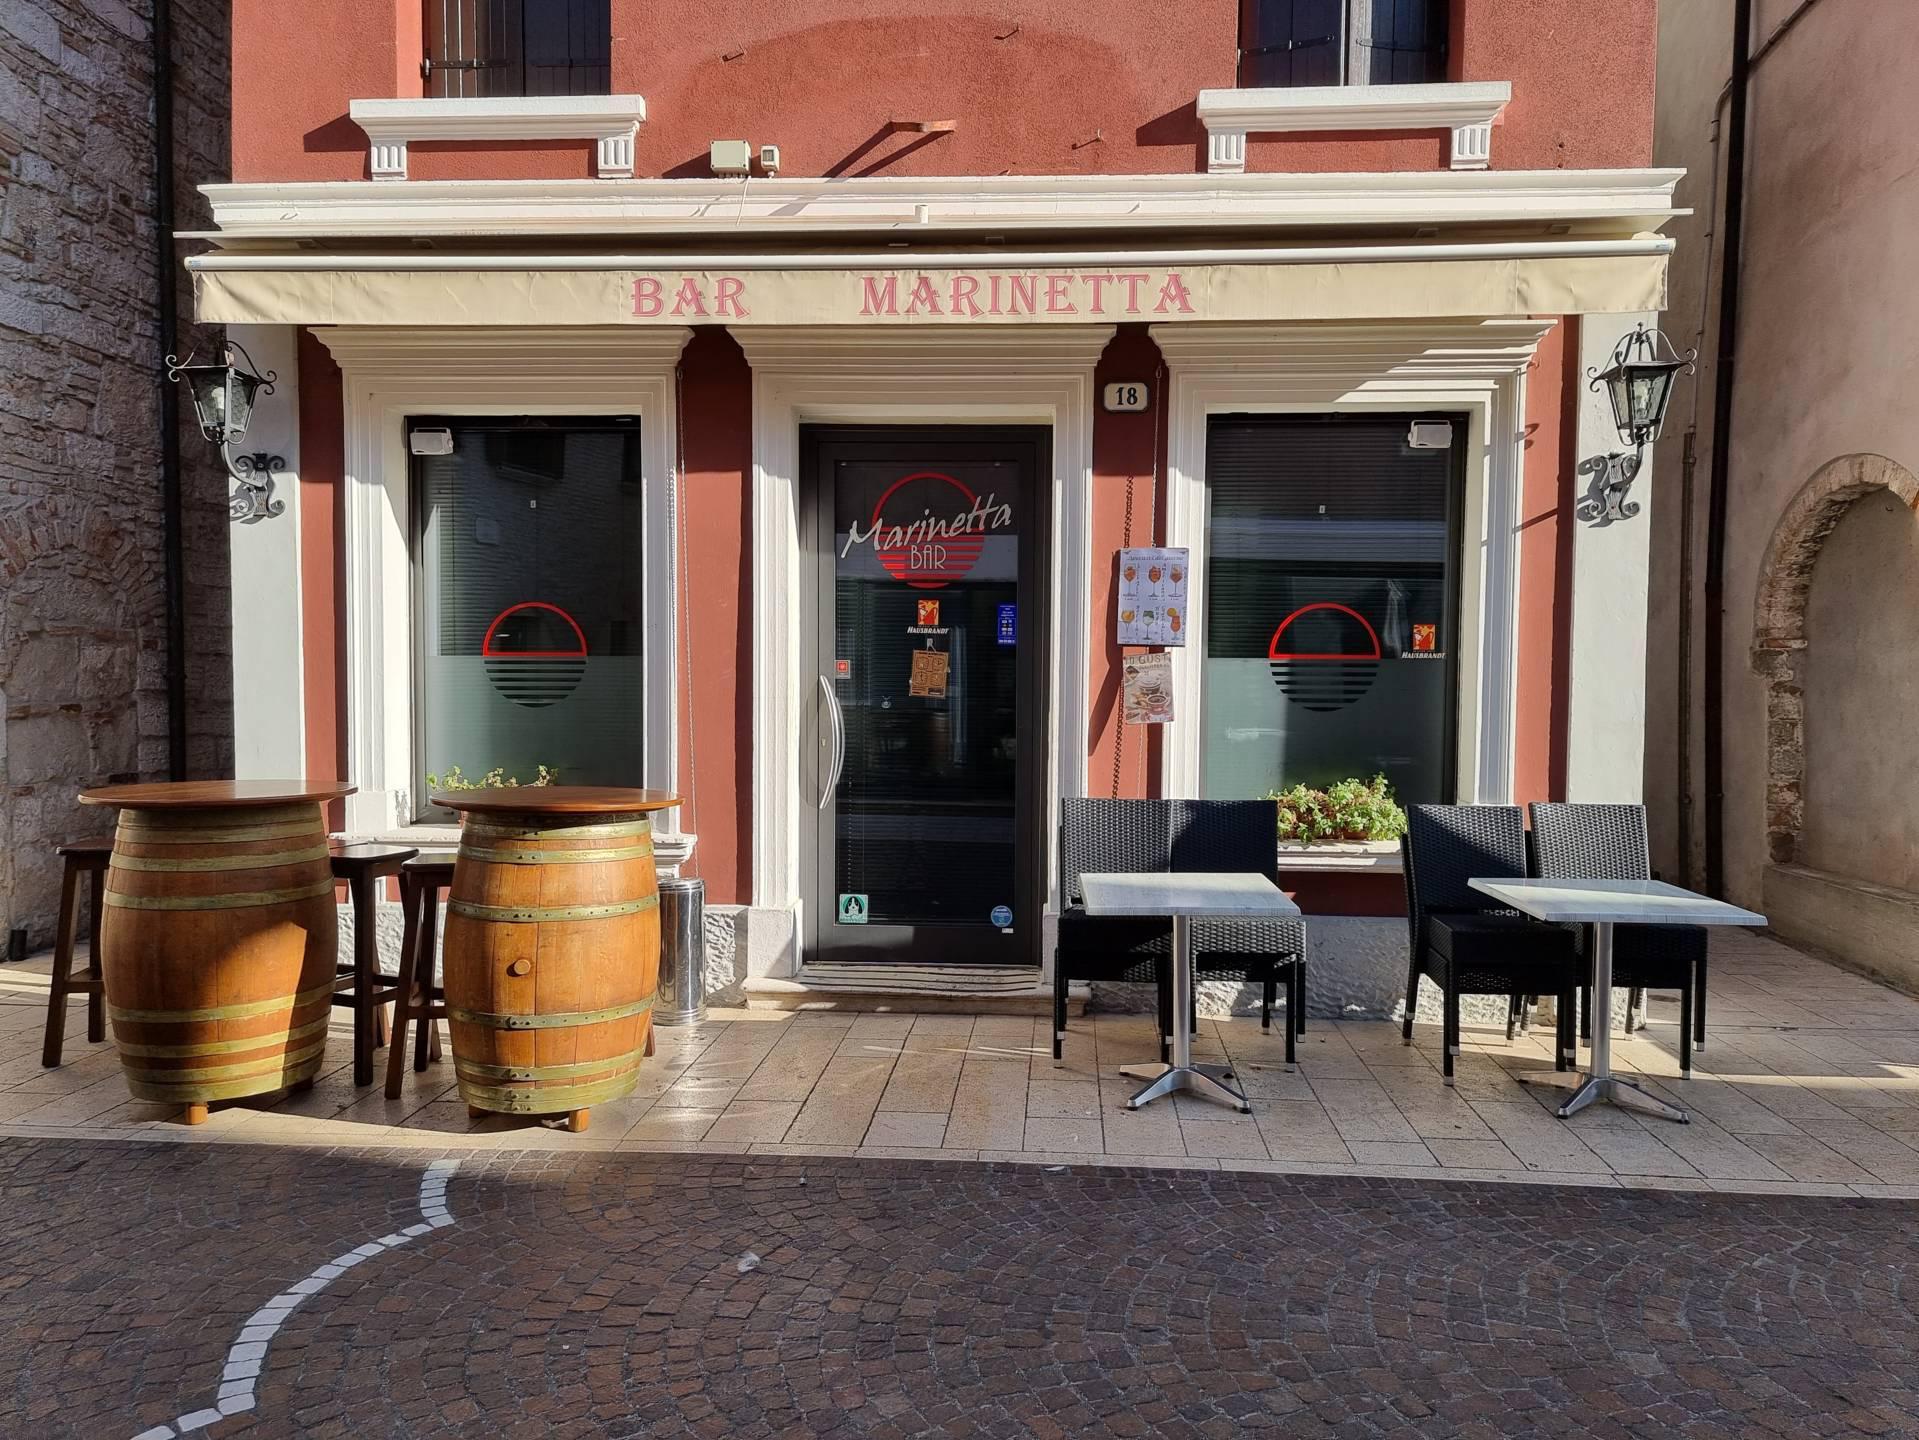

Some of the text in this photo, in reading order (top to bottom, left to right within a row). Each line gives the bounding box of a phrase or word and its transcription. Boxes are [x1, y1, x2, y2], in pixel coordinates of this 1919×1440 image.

[631, 273, 1196, 319] BAR MARINETTA
[1115, 386, 1138, 406] 18
[841, 493, 1012, 558] Marinetta
[910, 544, 947, 570] BAR
